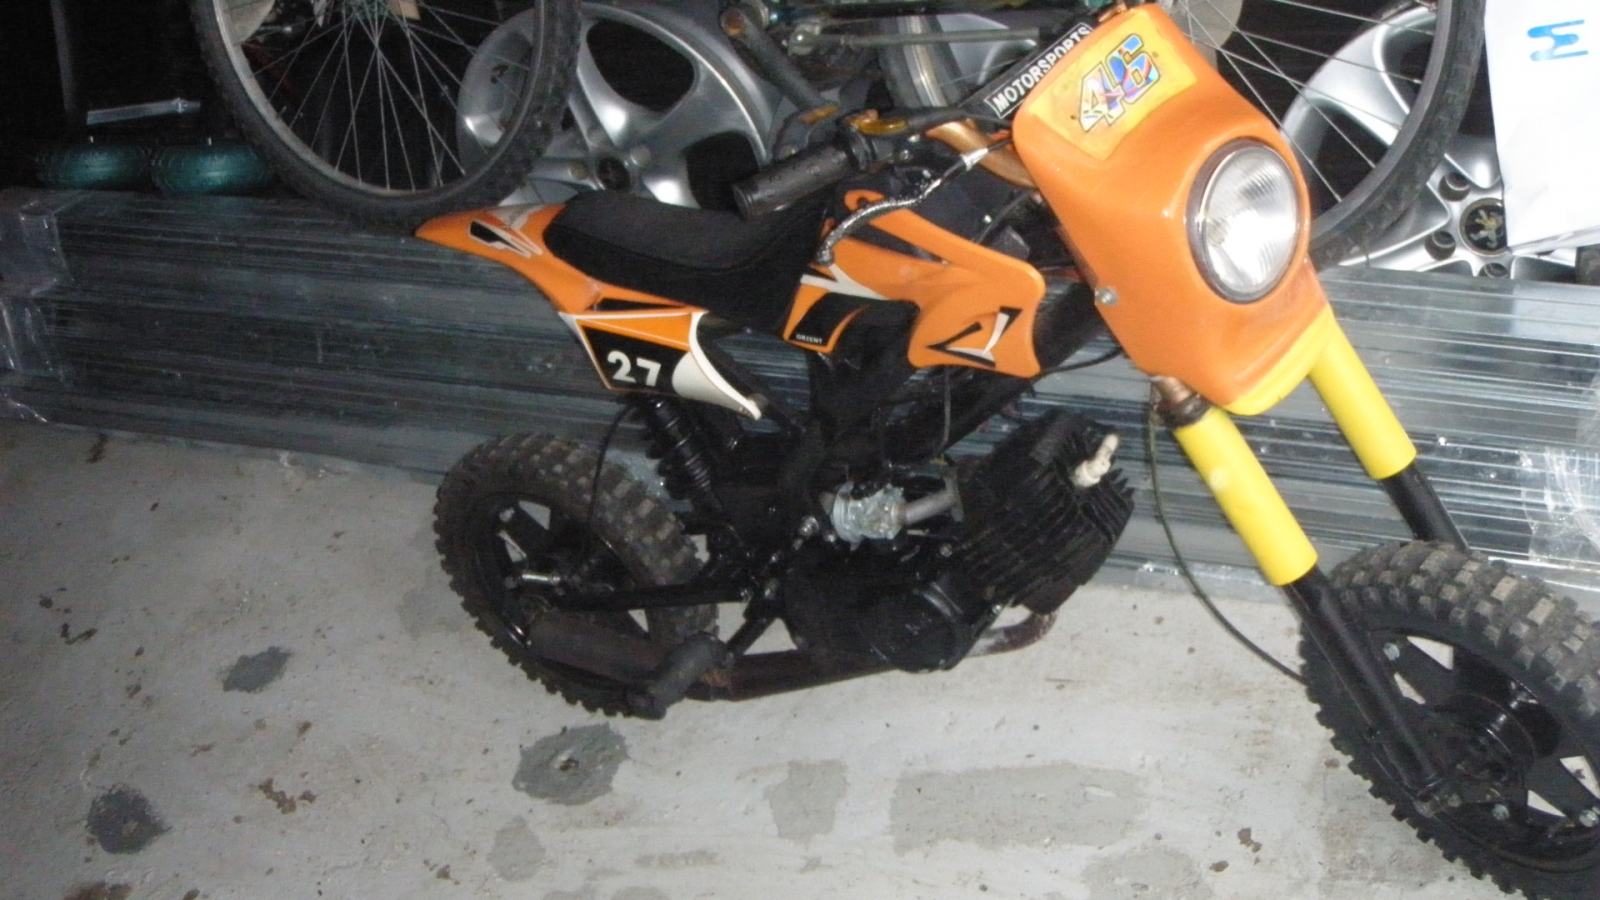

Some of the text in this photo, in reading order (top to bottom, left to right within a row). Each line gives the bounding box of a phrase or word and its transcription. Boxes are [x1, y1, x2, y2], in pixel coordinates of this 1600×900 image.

[992, 26, 1091, 113] MOTORSPORTS
[1079, 33, 1161, 132] 46
[607, 350, 662, 387] 27
